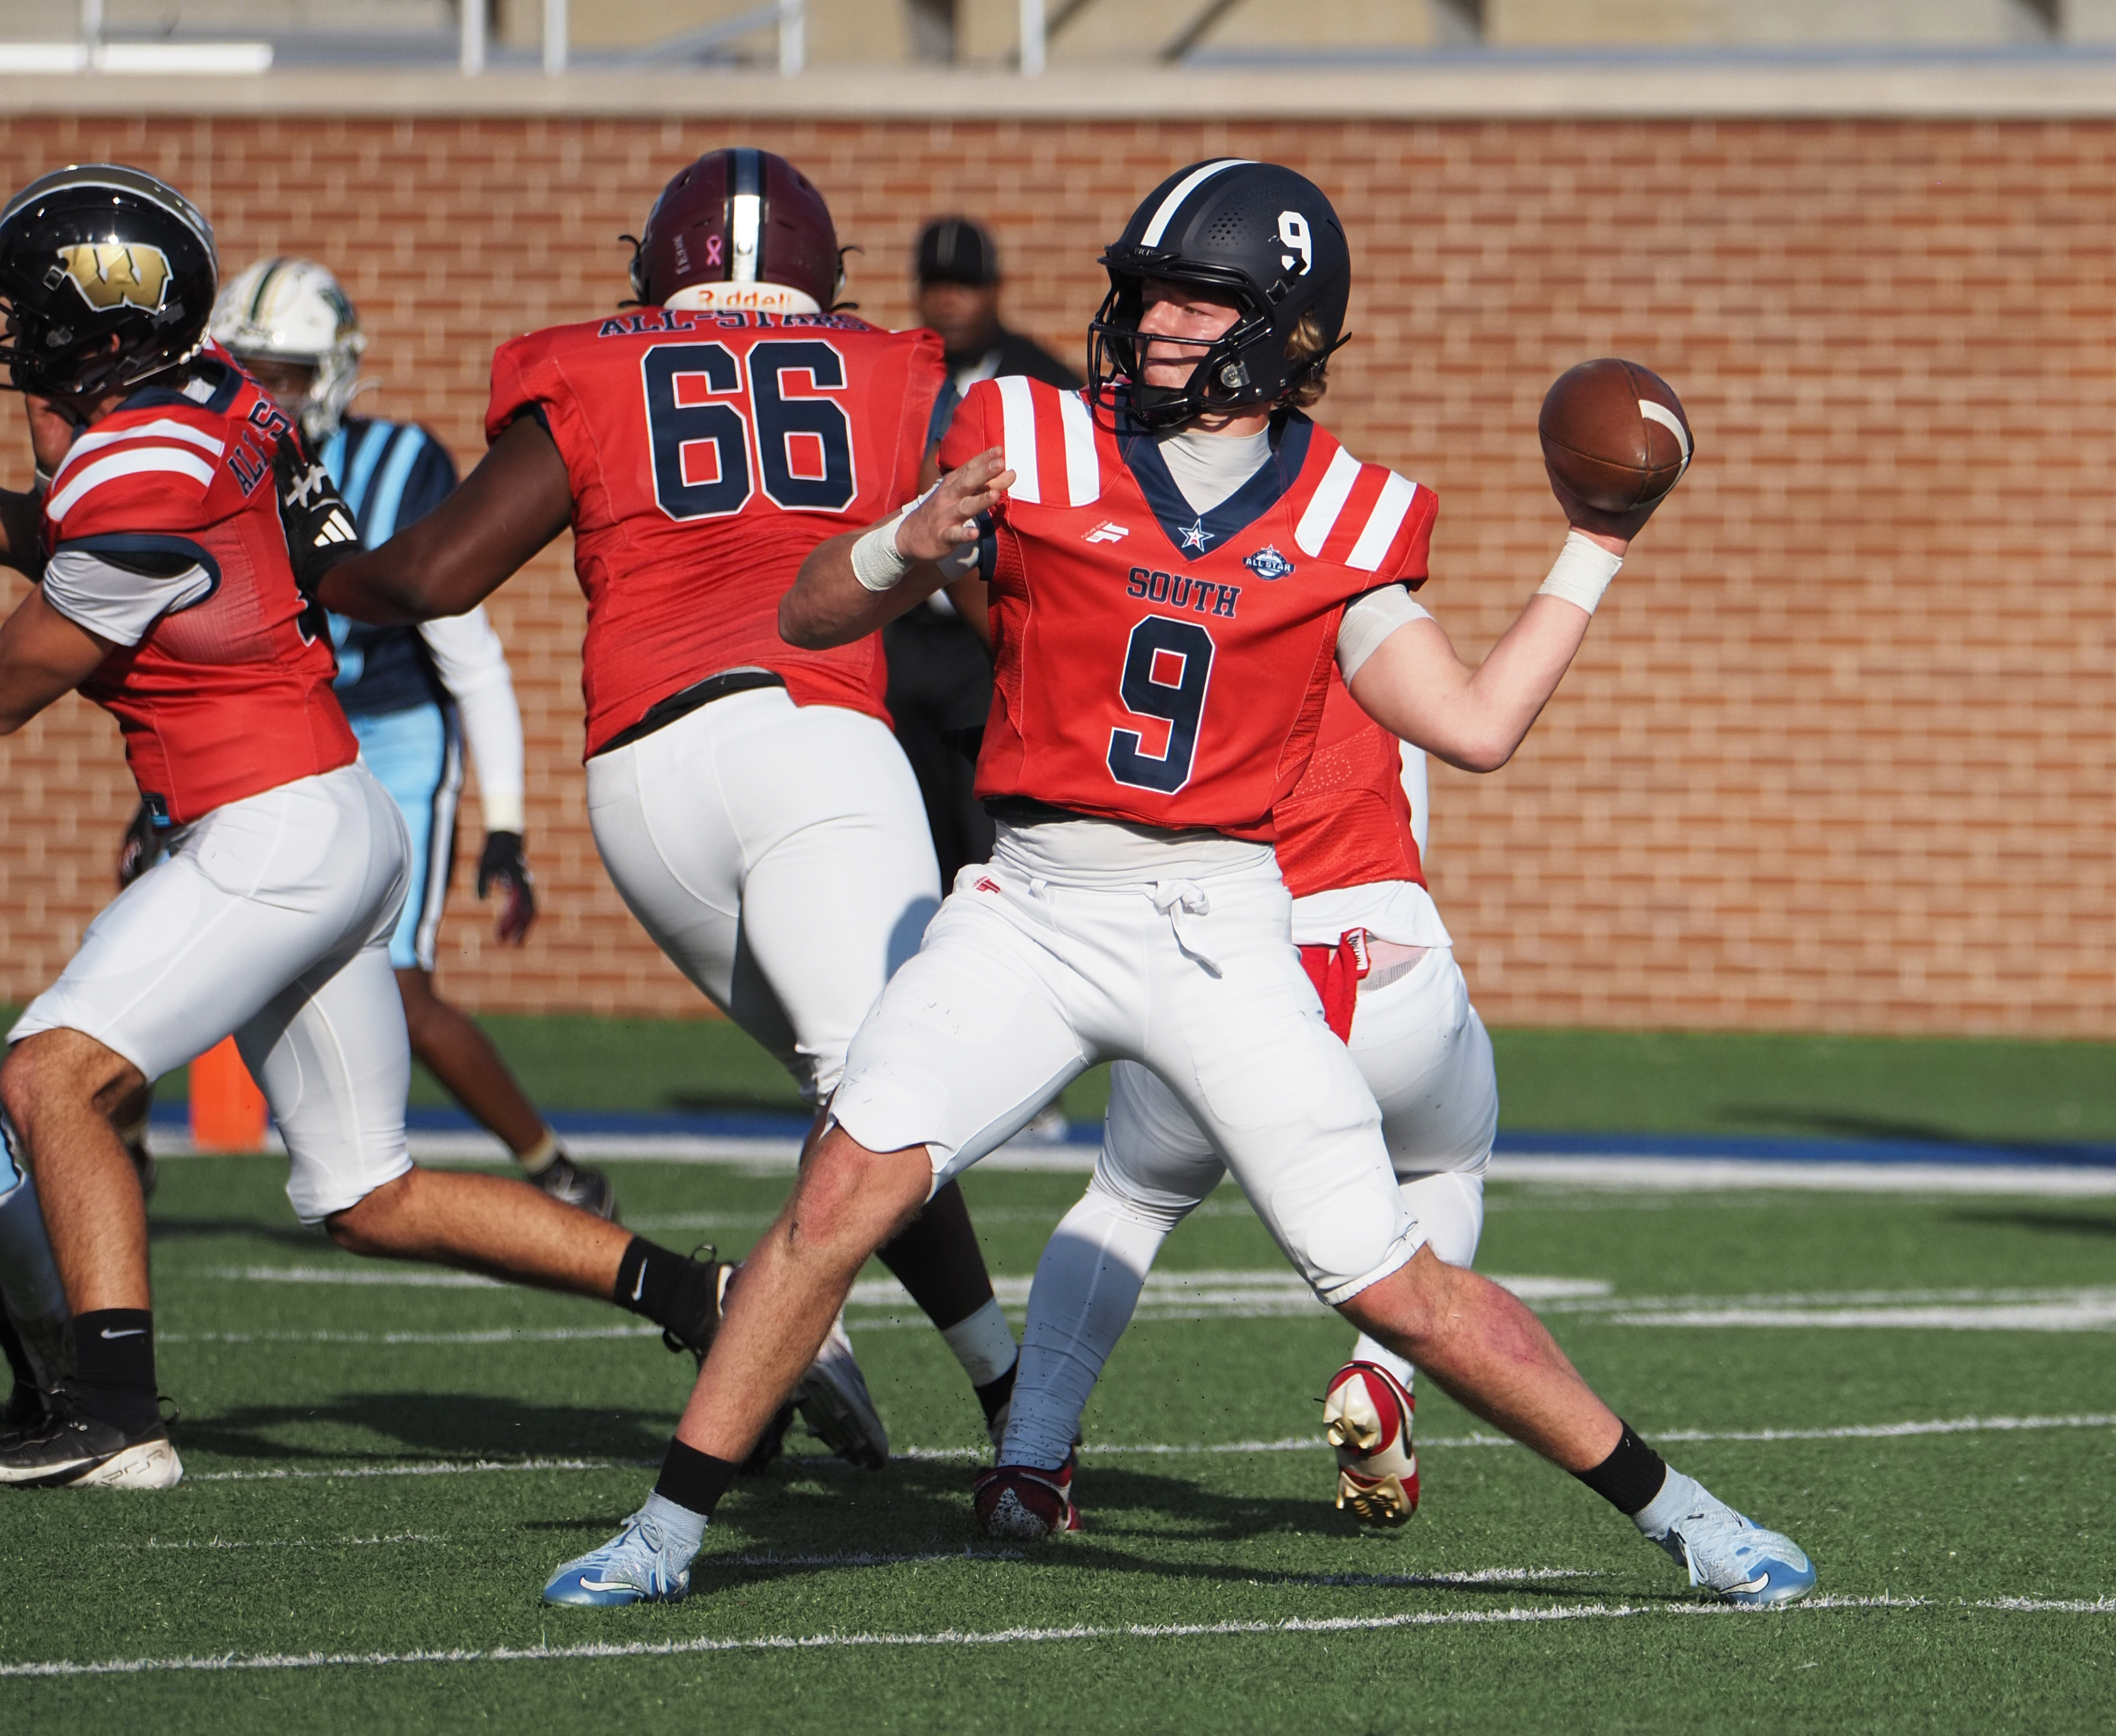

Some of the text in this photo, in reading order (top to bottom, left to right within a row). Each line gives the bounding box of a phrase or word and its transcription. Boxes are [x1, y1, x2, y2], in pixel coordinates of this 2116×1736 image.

[1277, 210, 1312, 276] 9
[56, 242, 174, 316] W
[698, 290, 793, 308] Riddell
[640, 338, 858, 523] 66
[1127, 566, 1242, 619] SOUTH
[1245, 558, 1263, 567] ALL
[1265, 560, 1291, 572] STAR
[1106, 614, 1216, 795] 9
